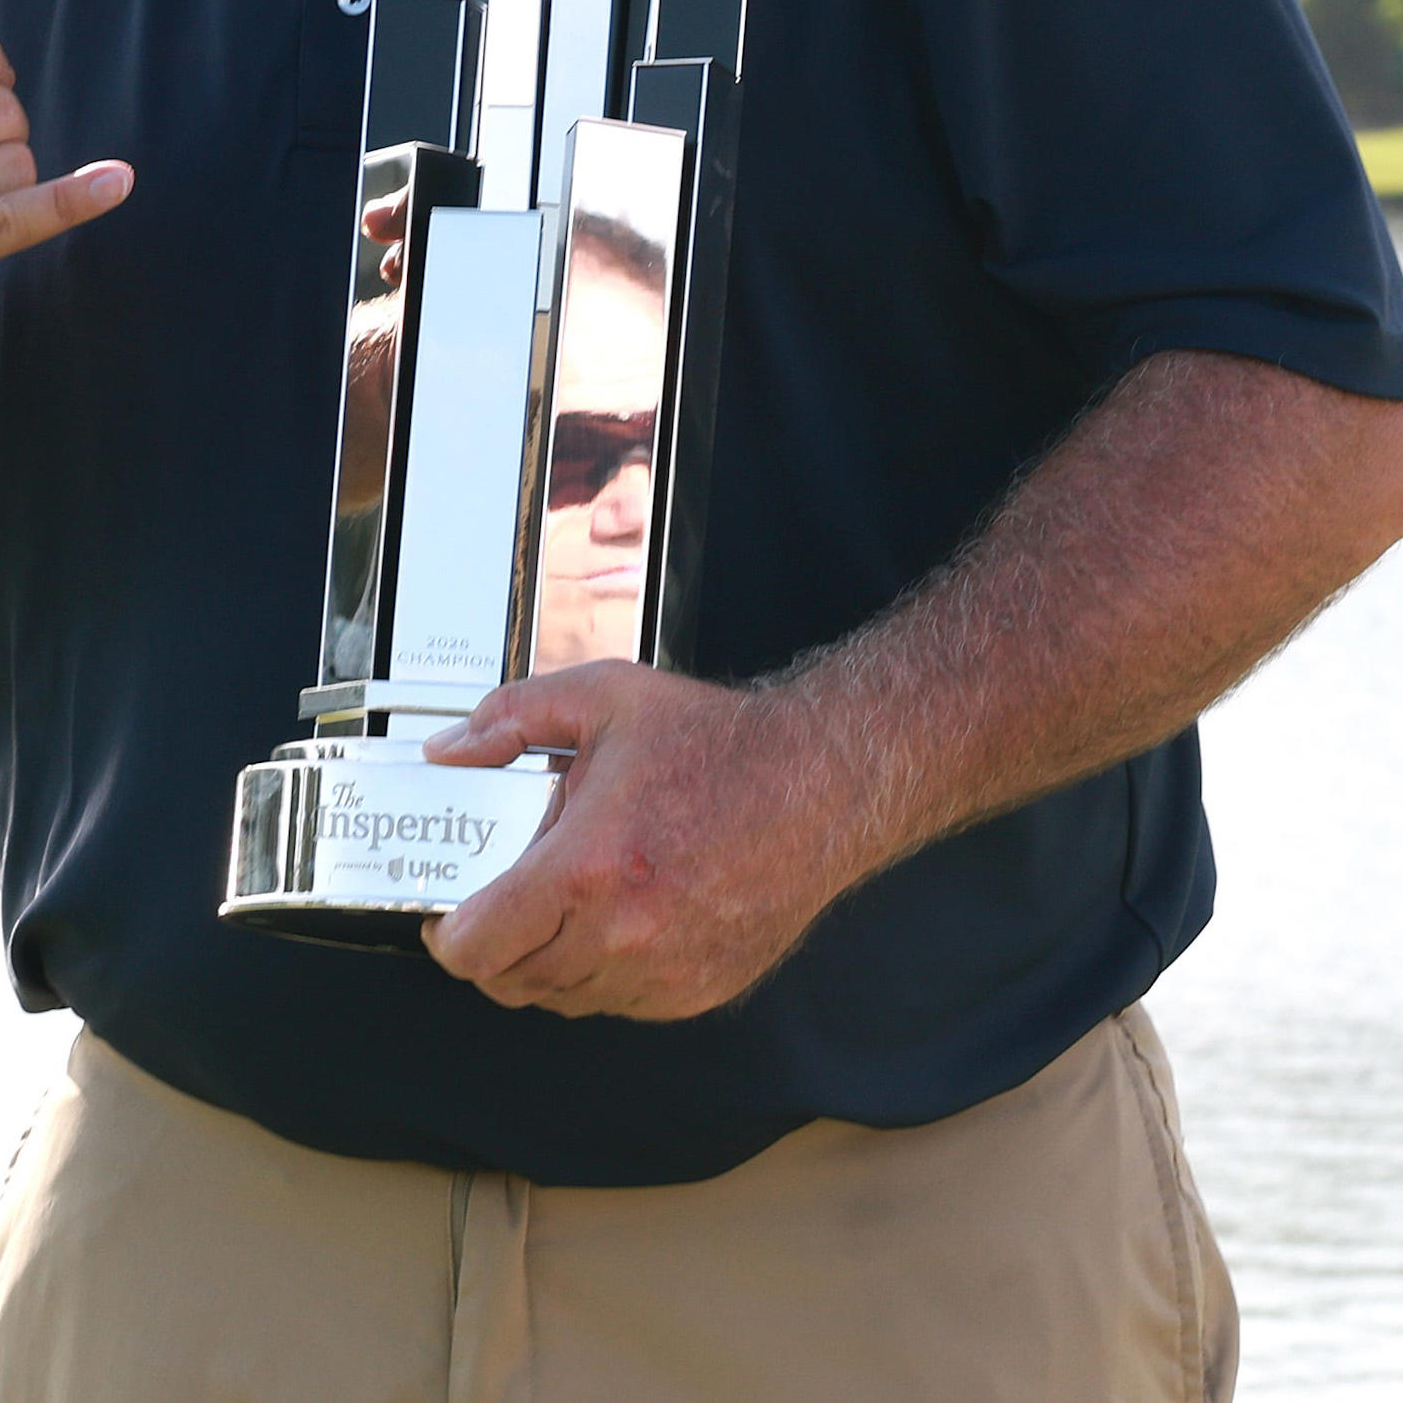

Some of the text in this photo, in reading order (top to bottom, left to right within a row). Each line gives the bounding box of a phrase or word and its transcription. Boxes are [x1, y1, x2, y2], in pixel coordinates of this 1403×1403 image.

[397, 651, 495, 669] CHAMPION
[332, 780, 364, 809] The
[315, 806, 498, 857] Insperity
[409, 859, 459, 880] UHC
